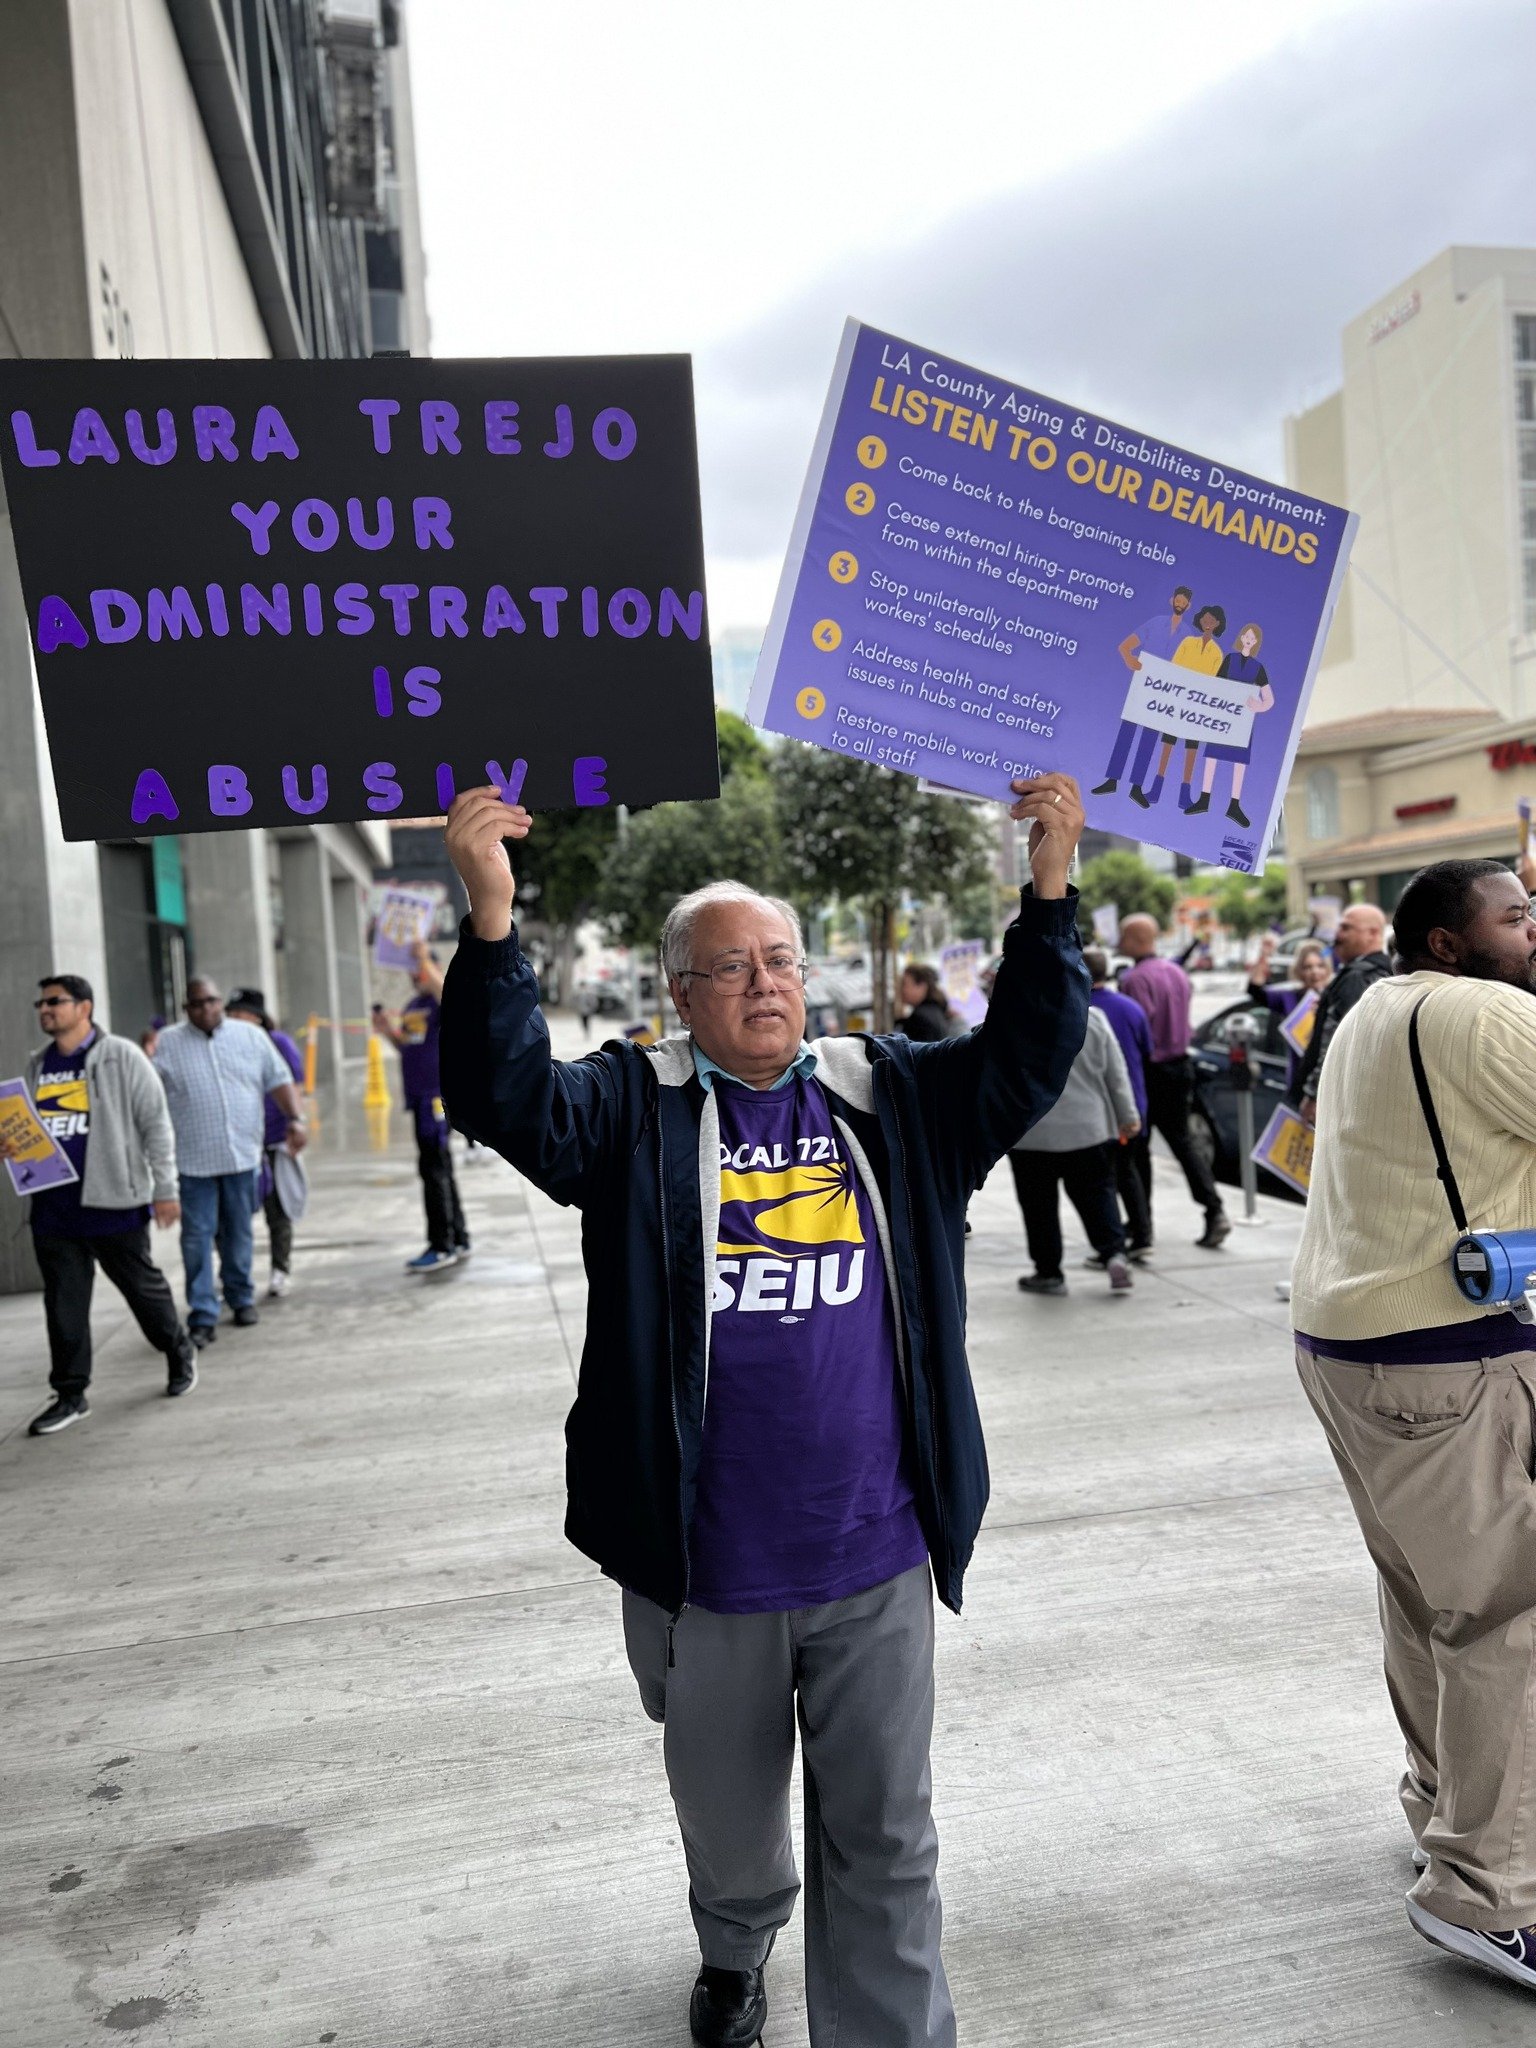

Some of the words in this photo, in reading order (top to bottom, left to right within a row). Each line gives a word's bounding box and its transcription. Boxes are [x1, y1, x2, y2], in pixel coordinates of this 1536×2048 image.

[11, 404, 300, 468] LAURA
[359, 399, 638, 461] TREJO
[880, 344, 911, 376] LA
[921, 360, 997, 409] County
[1001, 392, 1064, 435] Aging
[1070, 416, 1088, 440] &
[1094, 425, 1201, 482] Disabilities
[1207, 467, 1327, 527] Department:
[870, 376, 999, 451] LISTEN
[1007, 425, 1057, 470] TO
[1066, 451, 1143, 504] OUR
[1148, 478, 1319, 565] DEMANDS
[231, 496, 455, 555] YOUR
[898, 456, 948, 487] Come
[952, 473, 992, 503] back
[997, 492, 1014, 509] to
[1018, 498, 1043, 520] the
[1048, 507, 1132, 555] bargaining
[1136, 541, 1176, 565] table
[881, 524, 919, 551] from
[924, 543, 972, 569] within
[976, 558, 1001, 578] the
[1007, 568, 1099, 611] department
[887, 502, 940, 533] Cease
[945, 526, 1012, 558] external
[1014, 543, 1065, 578] hiring-
[1068, 568, 1134, 599] promote
[37, 583, 703, 654] ADMINISTRATION
[864, 597, 932, 629] workers'
[933, 619, 1013, 655] schedules
[869, 570, 909, 598] Stop
[914, 590, 1001, 631] unilaterally
[1005, 616, 1078, 656] changing
[373, 665, 442, 718] IS
[847, 663, 895, 690] issues
[900, 678, 914, 696] in
[918, 682, 956, 709] hubs
[961, 703, 993, 720] and
[995, 711, 1054, 738] centers
[852, 639, 919, 673] Address
[922, 659, 973, 690] health
[978, 684, 1010, 701] and
[1012, 691, 1061, 720] safety
[1144, 676, 1186, 697] DON'T
[1187, 690, 1243, 716] SILENCE
[832, 730, 848, 748] to
[853, 737, 874, 755] all
[876, 744, 918, 768] staff
[837, 705, 898, 739] Restore
[902, 730, 957, 756] mobile
[962, 747, 1000, 769] work
[1003, 761, 1047, 779] optio
[1146, 700, 1175, 718] OUR
[1179, 709, 1231, 734] VOICES!
[131, 756, 612, 825] ABUSIVE
[719, 1143, 790, 1169] OCAL
[711, 1249, 866, 1312] SEIU
